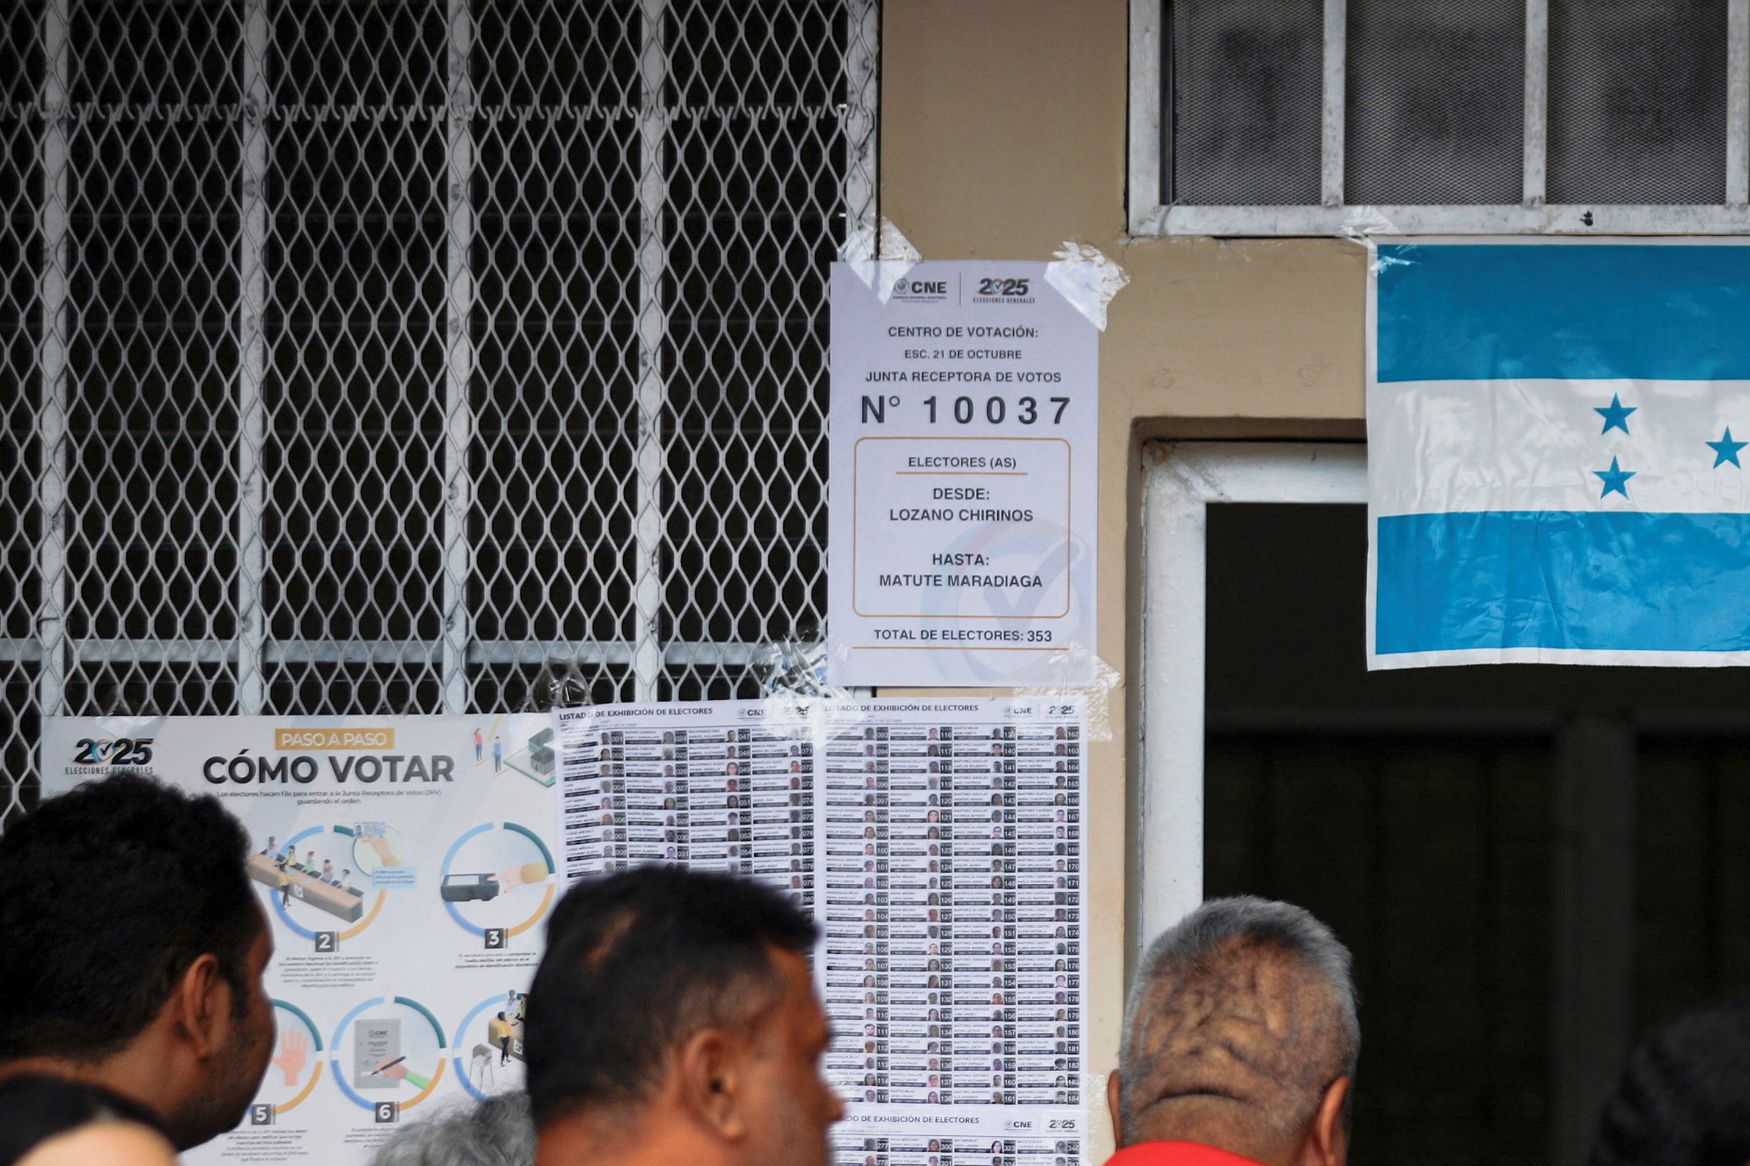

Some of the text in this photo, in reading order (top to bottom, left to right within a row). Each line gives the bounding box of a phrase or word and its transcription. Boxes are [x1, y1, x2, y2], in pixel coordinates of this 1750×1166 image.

[911, 281, 947, 295] CNE
[978, 278, 1030, 296] 2025
[888, 325, 1039, 339] CENTRO DE VOTACIÓN:
[904, 349, 1022, 360] ESC. 21 DE OCTUBRE
[866, 371, 1062, 383] JUNTA RECEPTORA DE VOTOS
[861, 395, 1071, 425] N° 10037
[908, 457, 1017, 469] ELECTORES (AS)
[933, 488, 990, 501] DESDE:
[890, 509, 1034, 522] LOZANO CHIRINOS
[932, 553, 990, 566] HASTA:
[880, 574, 1043, 587] MATUTE MARADIAGA
[874, 629, 1053, 642] TOTAL DE ELECTORES: 353
[559, 712, 592, 720] LISTAD
[607, 708, 654, 717] EXHIBICIÓN
[669, 707, 713, 715] ELECTORES
[873, 704, 920, 712] EXHIBICIÓN
[1048, 705, 1074, 715] 225
[281, 732, 388, 747] PASO A PASO
[73, 738, 155, 766] 2025
[65, 767, 109, 775] ELECCIONES
[203, 748, 455, 785] CÓMO VOTAR
[319, 933, 331, 949] 2
[489, 930, 500, 946] 3
[255, 1106, 268, 1122] 5
[378, 1104, 392, 1120] 6
[874, 1115, 921, 1123] EXHIBICIÓN
